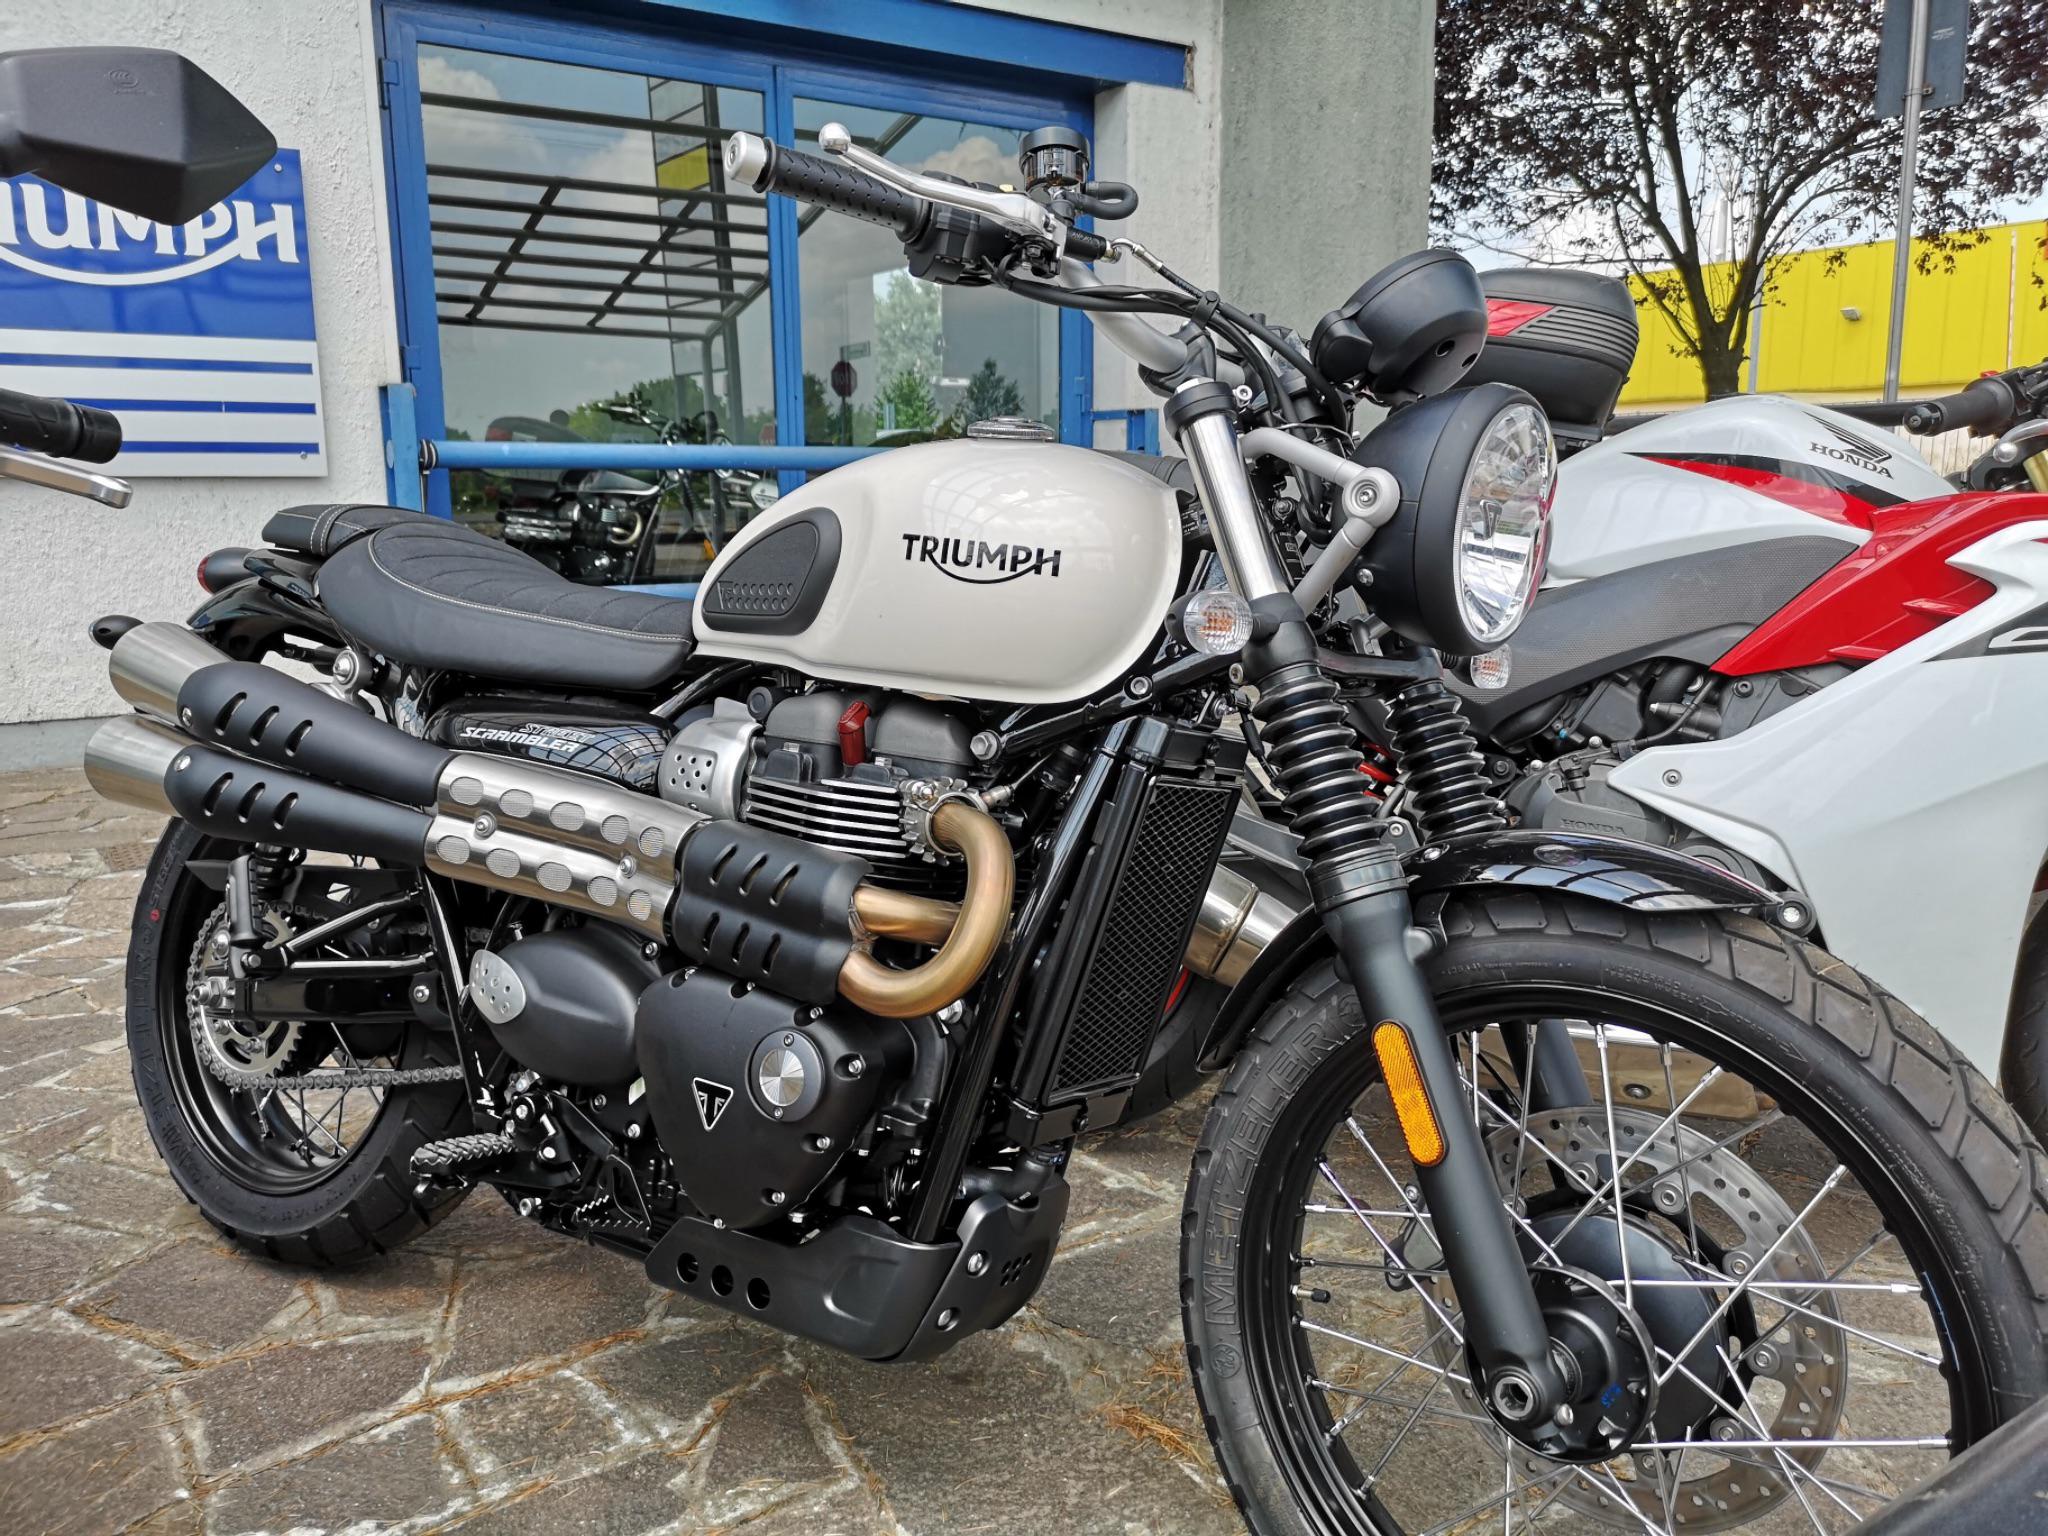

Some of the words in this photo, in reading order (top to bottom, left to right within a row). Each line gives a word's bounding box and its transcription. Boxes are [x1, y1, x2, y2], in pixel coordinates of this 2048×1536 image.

[1809, 441, 1895, 480] HONDA
[902, 533, 1062, 584] TRIUMPH
[460, 727, 580, 753] SCRAMBLER
[1561, 818, 1628, 836] HONDA
[1203, 1020, 1335, 1326] METZELER
